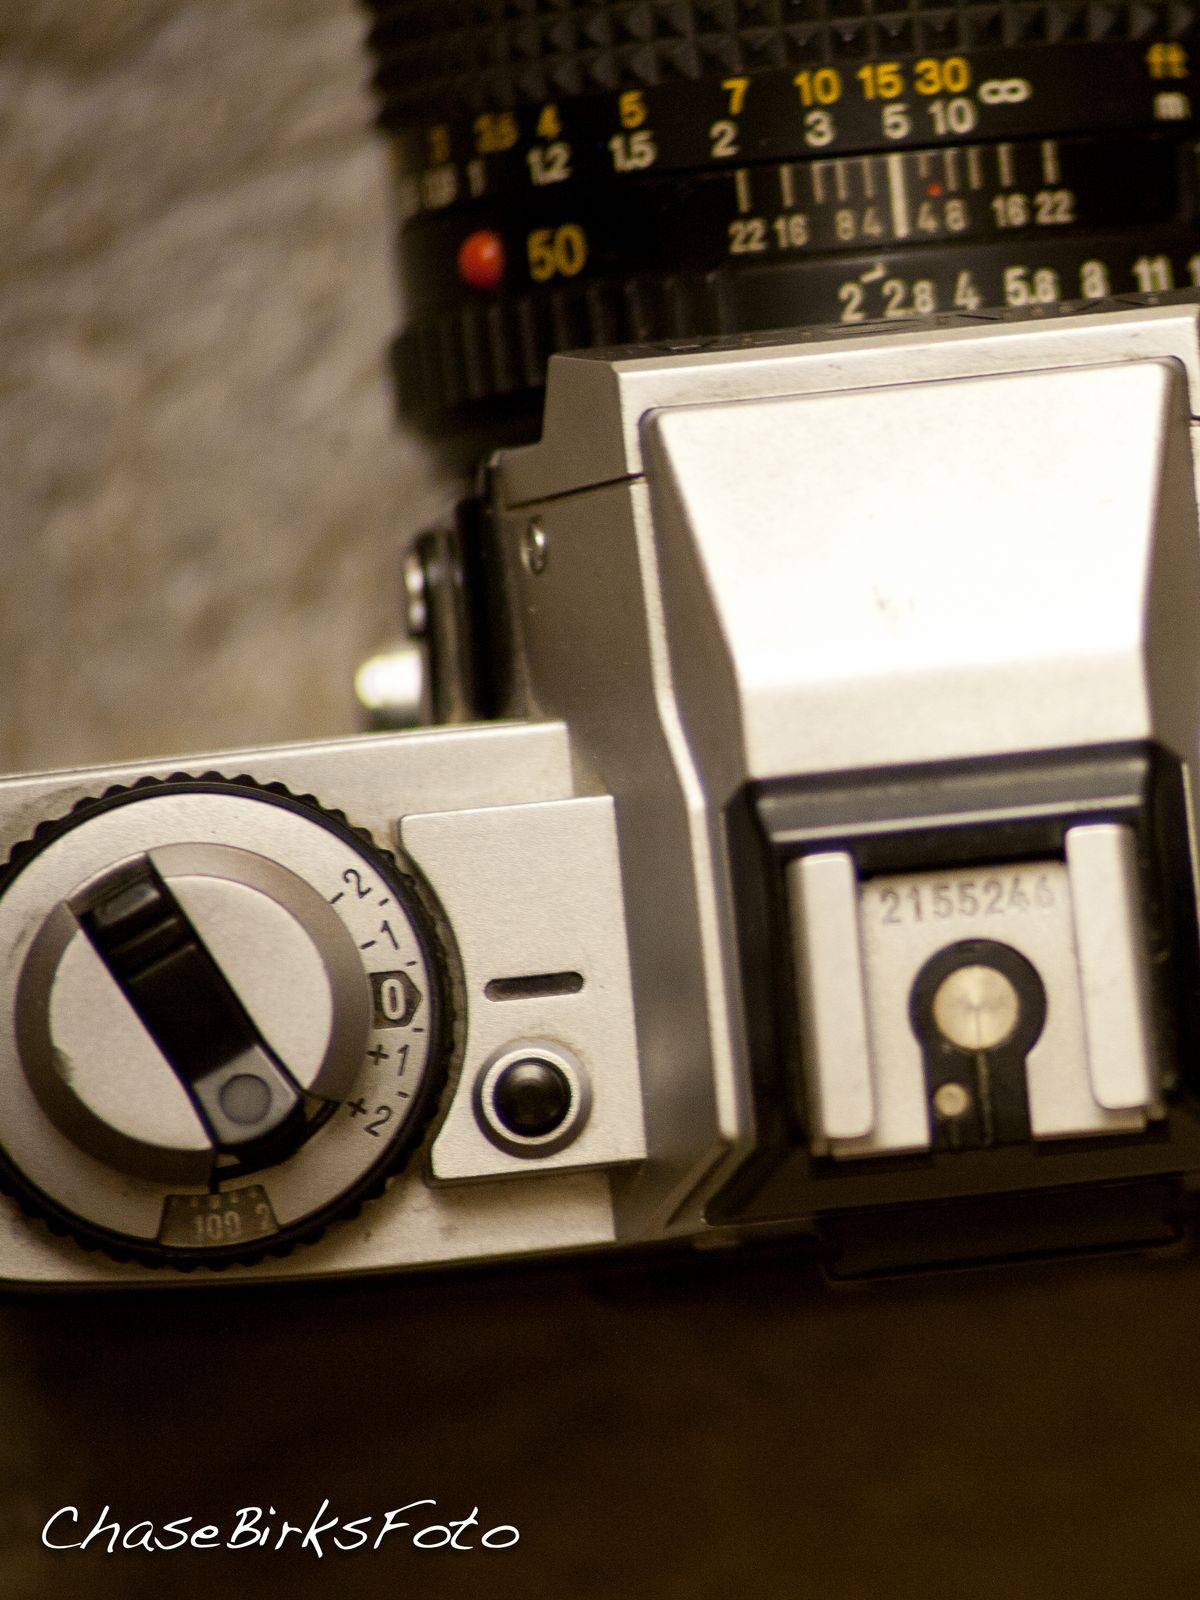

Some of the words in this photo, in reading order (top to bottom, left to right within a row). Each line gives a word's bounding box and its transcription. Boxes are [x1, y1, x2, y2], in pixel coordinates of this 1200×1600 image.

[537, 102, 561, 139] 4
[619, 89, 648, 130] 5
[722, 76, 750, 116] 7
[795, 68, 842, 107] 10
[857, 62, 905, 100] 15
[913, 56, 971, 95] 30
[711, 119, 739, 159] 2
[803, 110, 836, 147] 3
[882, 103, 911, 140] 5
[928, 97, 977, 136] 10
[526, 224, 589, 283] 50
[728, 217, 767, 255] 22
[834, 208, 856, 241] 8
[862, 206, 883, 237] 4
[917, 202, 939, 234] 4
[1034, 188, 1075, 224] 22
[838, 282, 866, 323] 2
[954, 268, 981, 312] 4
[1132, 254, 1172, 294] 11
[380, 978, 405, 1021] 0
